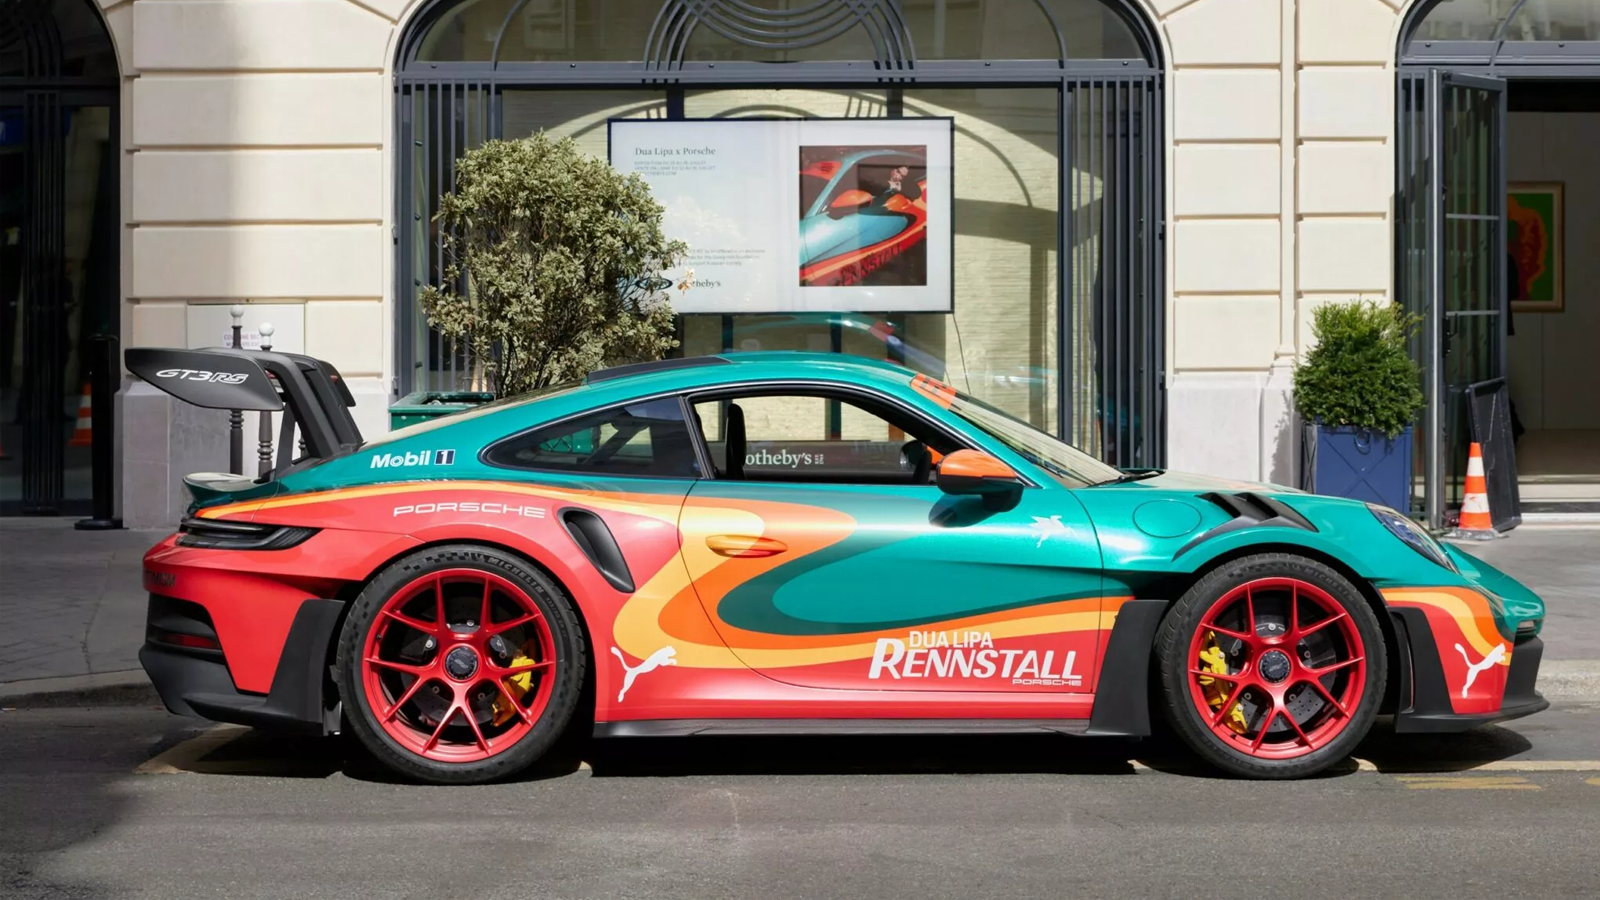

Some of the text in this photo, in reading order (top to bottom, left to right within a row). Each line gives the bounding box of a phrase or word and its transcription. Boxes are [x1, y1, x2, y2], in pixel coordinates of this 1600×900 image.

[635, 147, 652, 156] Dua
[654, 147, 674, 157] Lipa
[683, 146, 717, 156] Porsche
[370, 450, 431, 469] Mobil
[745, 449, 813, 469] otheby's
[393, 502, 546, 519] PORSCHE
[486, 557, 546, 595] MICHELIN
[909, 630, 994, 649] DUA LIPA
[868, 638, 1082, 679] RENNSTALL
[1012, 679, 1082, 687] PORSCHE
